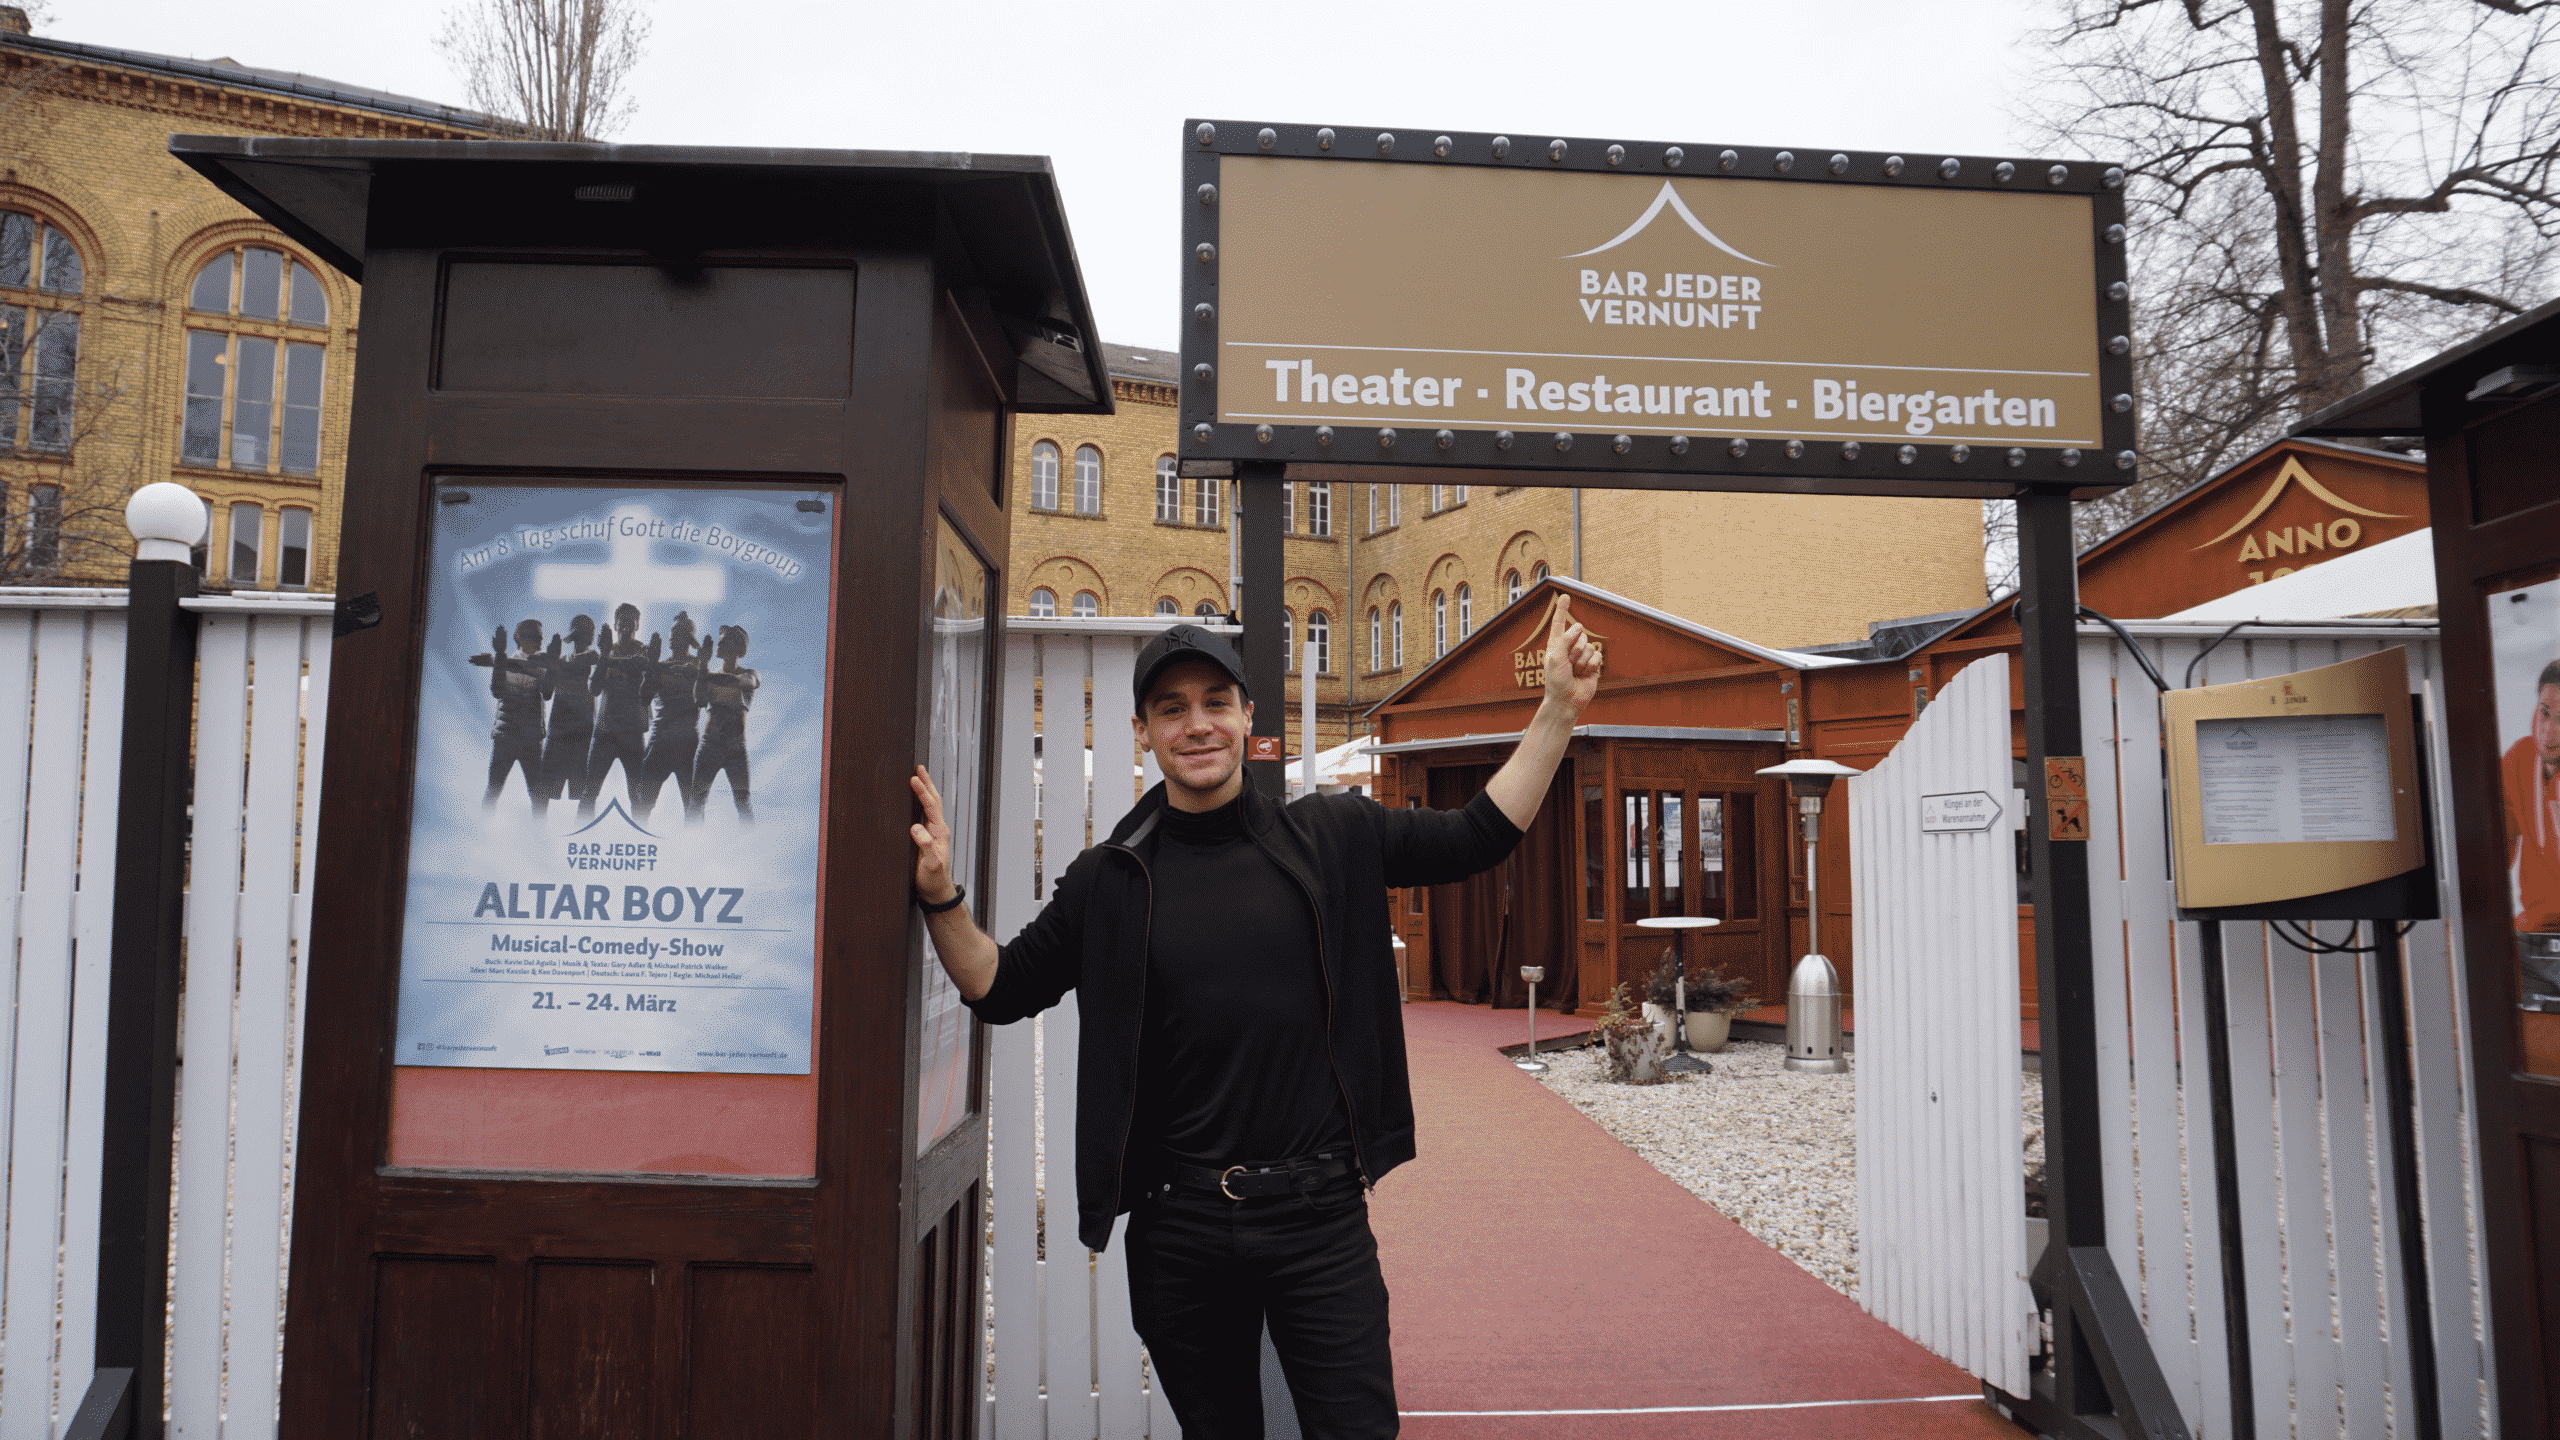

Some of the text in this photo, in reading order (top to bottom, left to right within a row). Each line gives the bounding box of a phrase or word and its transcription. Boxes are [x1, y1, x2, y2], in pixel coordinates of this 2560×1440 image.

[1579, 269, 1763, 302] BAR JEDER
[1578, 298, 1763, 330] VERNUNFT
[1265, 359, 1462, 408] Theater
[1506, 367, 1772, 419] Restaurant
[1813, 378, 2056, 435] Biergarten
[460, 547, 491, 573] Am
[515, 529, 552, 550] Tag
[560, 515, 615, 541] schuf
[619, 516, 665, 538] Gott
[671, 519, 701, 543] die
[706, 525, 803, 578] Boygroup
[2237, 517, 2361, 563] ANNO
[1944, 799, 1963, 810] Klingel
[566, 856, 657, 871] VERNUNFT
[567, 842, 657, 857] BAR JEDER
[473, 881, 744, 924] ALTAR BOYZ
[490, 933, 724, 960] Musical-Comedy-Show
[532, 991, 562, 1010] 21.
[586, 992, 620, 1011] 24.
[626, 993, 677, 1013] März
